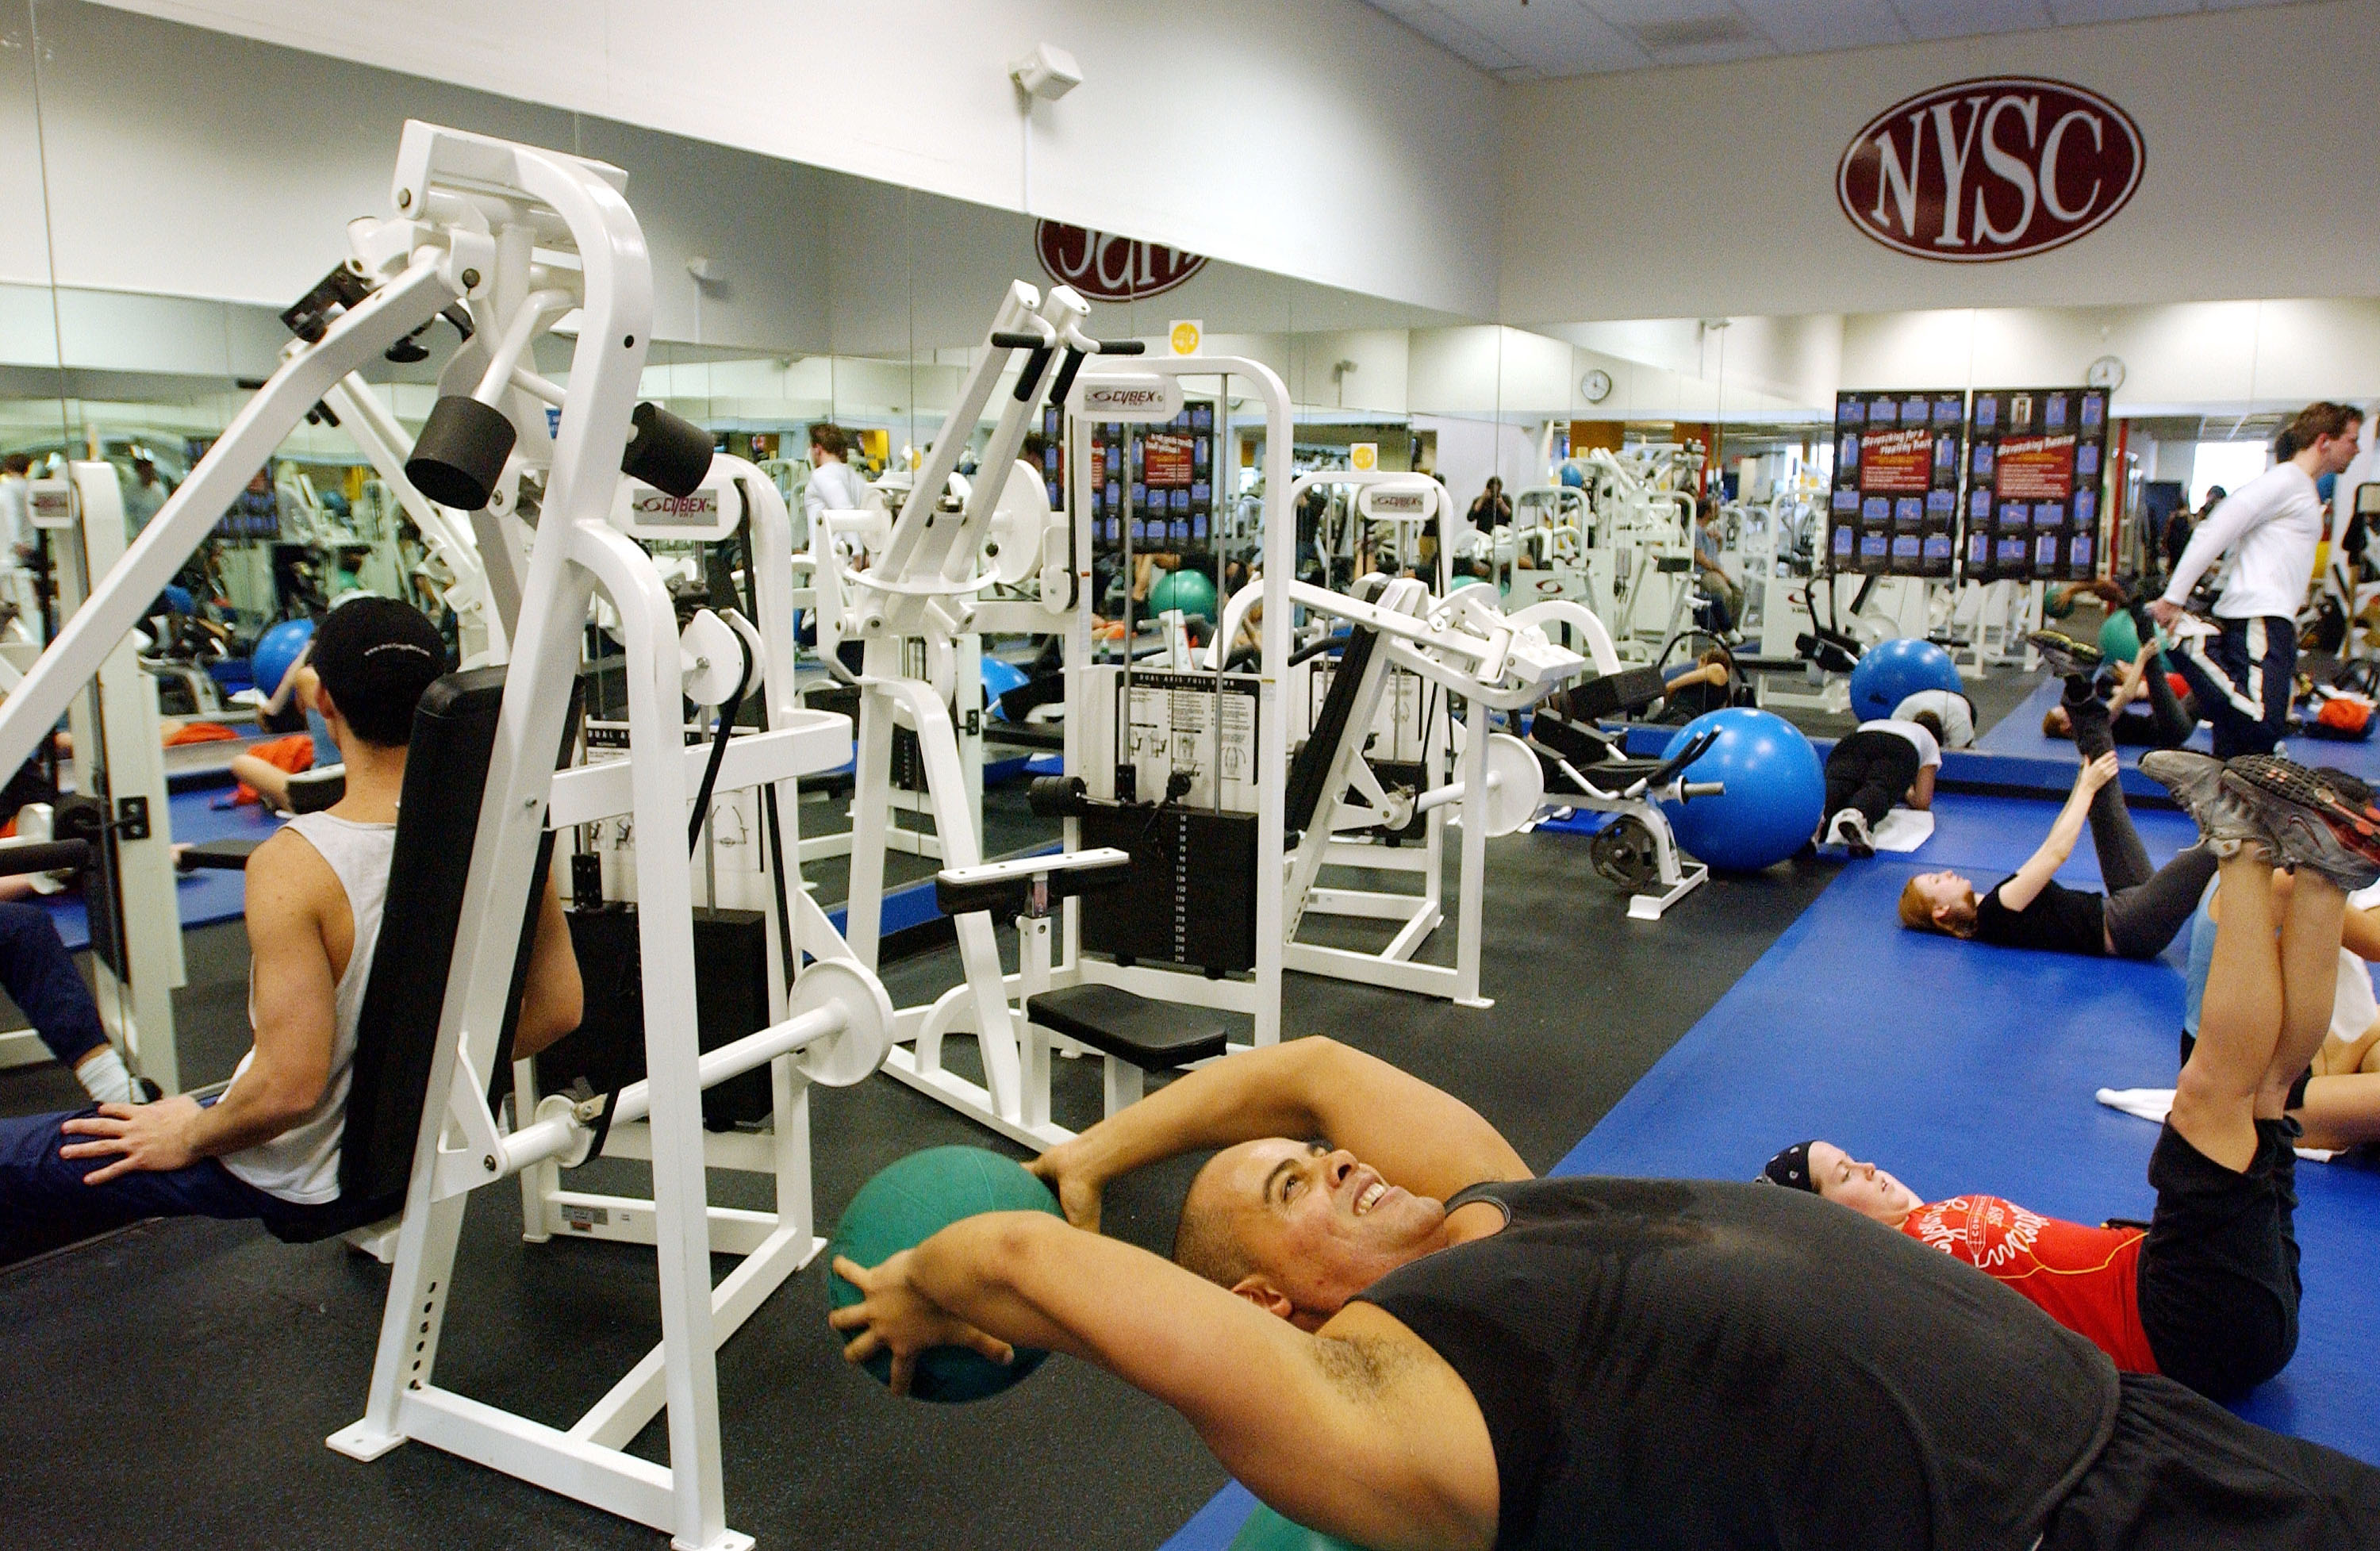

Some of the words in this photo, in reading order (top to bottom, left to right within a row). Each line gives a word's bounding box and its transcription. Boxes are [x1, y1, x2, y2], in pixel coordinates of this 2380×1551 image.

[1871, 94, 2103, 246] NYSC
[1112, 390, 1155, 405] CYBEX
[662, 497, 708, 516] CYBEX
